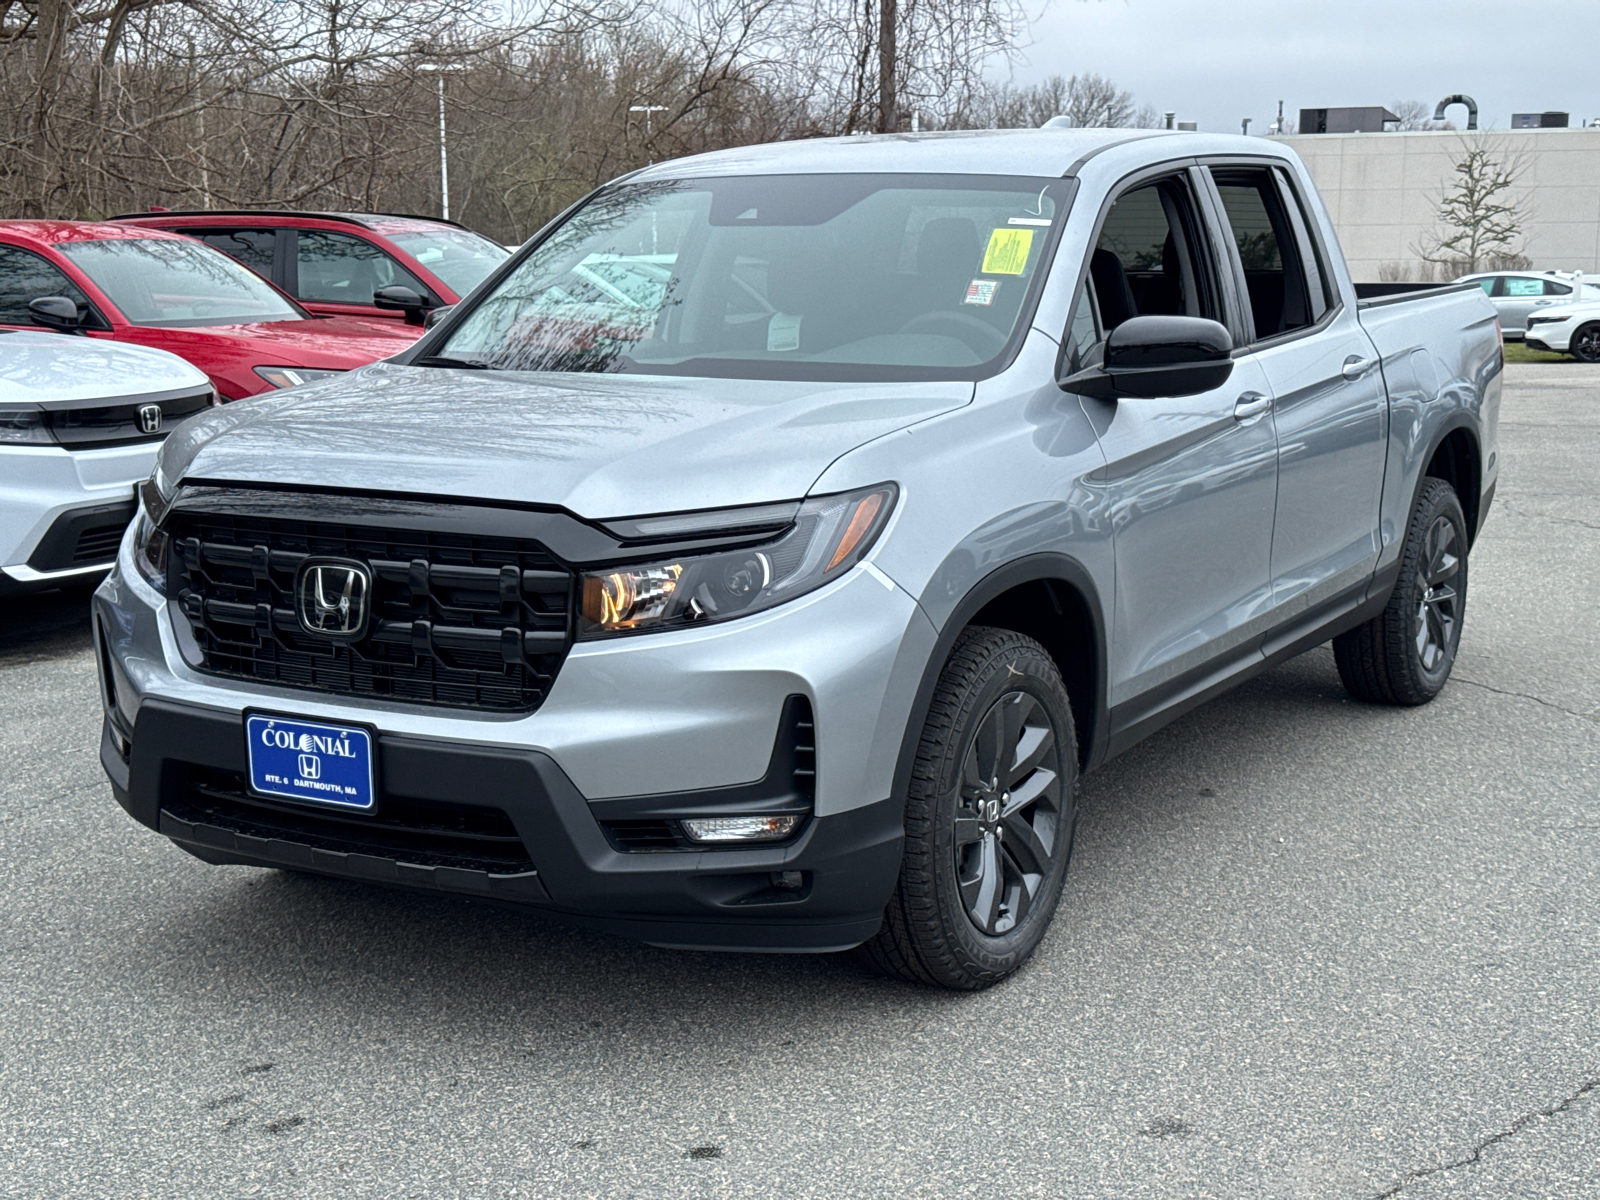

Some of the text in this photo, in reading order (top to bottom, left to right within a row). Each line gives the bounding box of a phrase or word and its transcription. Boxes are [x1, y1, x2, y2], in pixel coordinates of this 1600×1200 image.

[262, 729, 356, 758] COLONIAL
[265, 774, 357, 795] RTE. 6 DARTMOUTH, MA
